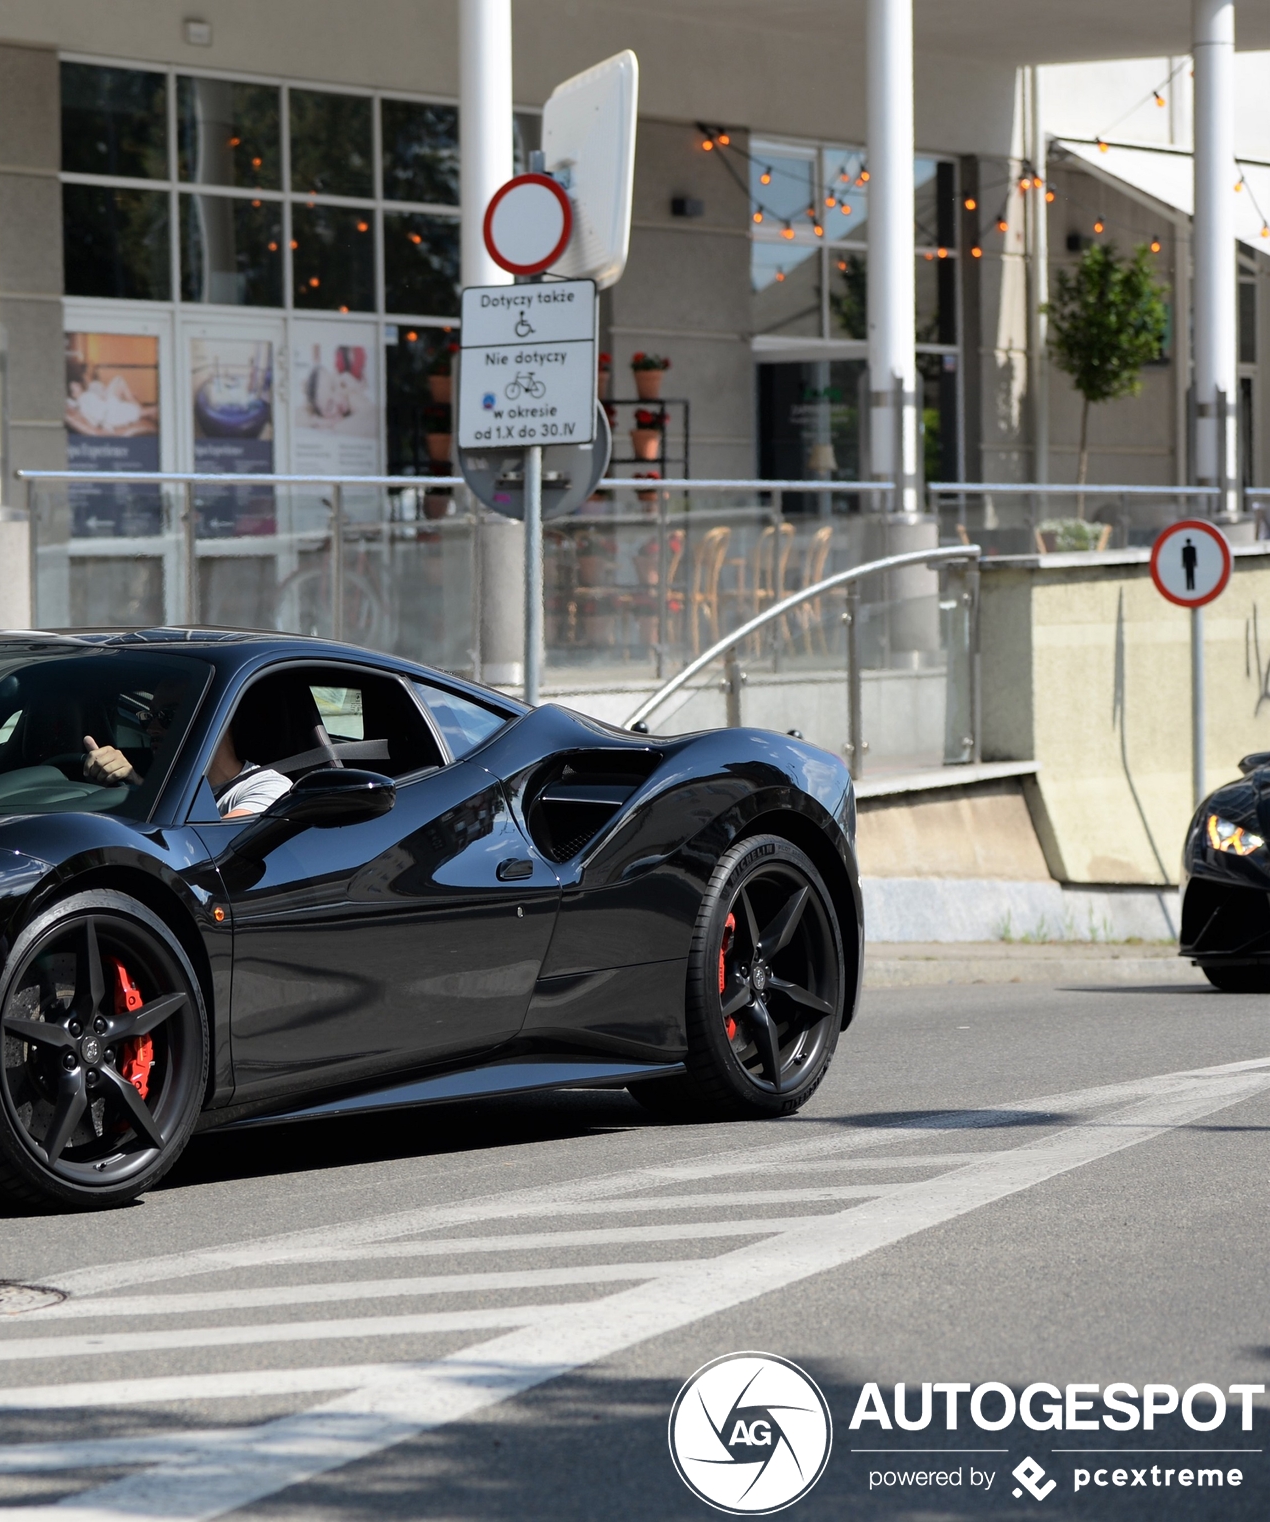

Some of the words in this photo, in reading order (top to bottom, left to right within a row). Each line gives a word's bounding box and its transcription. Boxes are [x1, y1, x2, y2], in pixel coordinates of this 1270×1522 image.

[481, 293, 533, 310] Dotyczy
[537, 290, 575, 304] także
[485, 352, 509, 366] Nie
[514, 350, 568, 366] dotyczy
[493, 410, 504, 419] w
[508, 404, 558, 419] okresie
[474, 427, 492, 440] od
[496, 425, 514, 440] 1.X
[518, 425, 536, 438] do
[541, 422, 576, 438] 30.IV
[730, 843, 775, 886] MICHELIN
